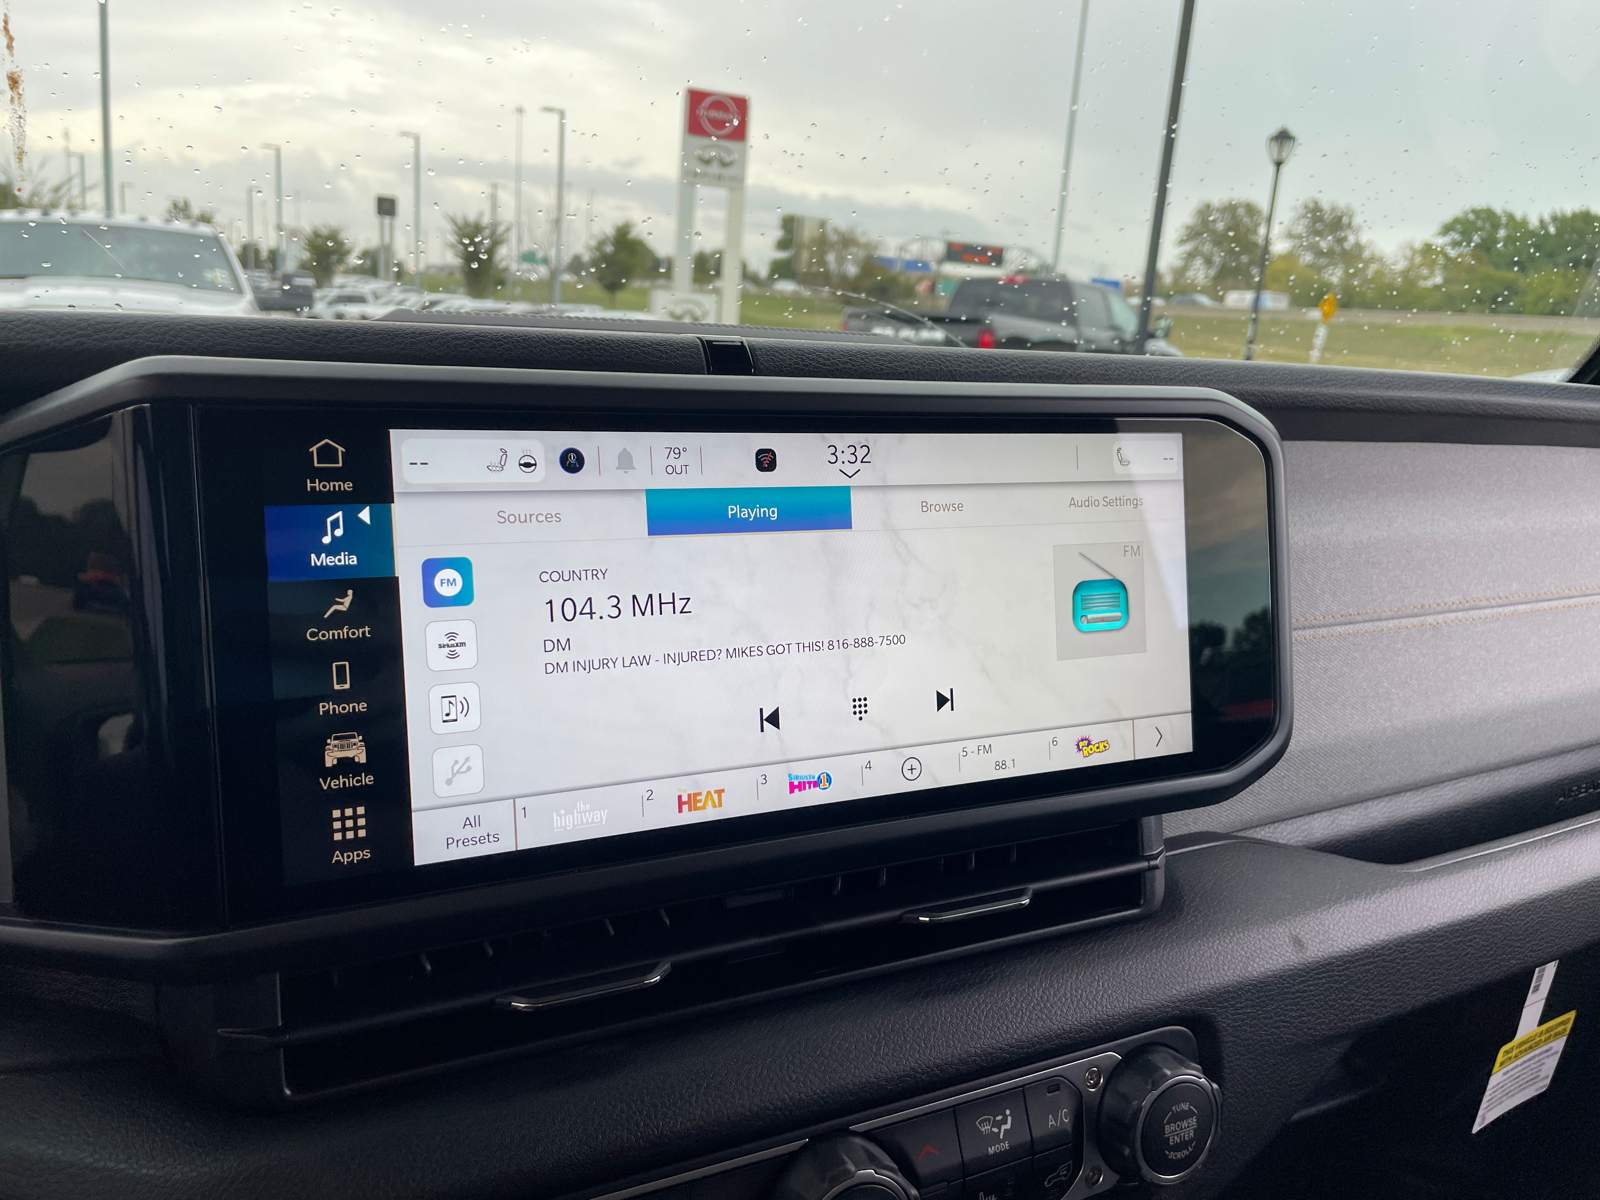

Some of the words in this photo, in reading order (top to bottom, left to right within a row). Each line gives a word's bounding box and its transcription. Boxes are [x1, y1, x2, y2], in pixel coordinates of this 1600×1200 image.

[826, 444, 872, 465] 3:32
[665, 464, 689, 475] OUT
[306, 478, 353, 493] Home
[920, 499, 964, 514] Browse
[1068, 495, 1100, 509] Audio
[1102, 494, 1144, 510] Settings
[496, 509, 562, 526] Sources
[727, 503, 778, 522] Playing
[310, 551, 357, 567] Media
[1123, 545, 1141, 558] FM
[440, 578, 457, 588] FM
[539, 568, 608, 583] COUNTRY
[545, 594, 622, 623] 104.3
[631, 592, 692, 617] MHz
[306, 627, 371, 642] Comfort
[543, 637, 571, 653] DM
[544, 661, 569, 675] DM
[572, 656, 619, 674] INJURY
[622, 654, 652, 668] LAW
[663, 648, 723, 666] INJURED?
[725, 645, 764, 659] MIKES
[766, 643, 792, 656] GOT
[795, 640, 825, 653] THIS!
[827, 634, 906, 652] 816-888-7500
[318, 700, 368, 716] Phone
[1051, 736, 1058, 747] 6
[1082, 740, 1110, 757] ROCKS
[962, 746, 968, 757] 5
[977, 744, 992, 755] FM
[864, 760, 873, 771] 4
[994, 758, 1016, 771] 88.1
[319, 774, 374, 791] Vehicle
[760, 774, 768, 785] 3
[645, 790, 654, 801] 2
[677, 788, 725, 814] HEAT
[522, 806, 527, 819] 1
[577, 801, 591, 812] the
[462, 814, 482, 829] All
[553, 809, 608, 830] highway
[446, 832, 500, 850] Presets
[331, 849, 371, 865] Apps
[1172, 1102, 1190, 1114] TUNE
[1048, 1108, 1070, 1128] A/C
[1164, 1115, 1198, 1134] BROWSE
[1169, 1129, 1195, 1146] ENTER
[988, 1140, 1010, 1155] MODE
[1168, 1145, 1193, 1160] SCROLL
